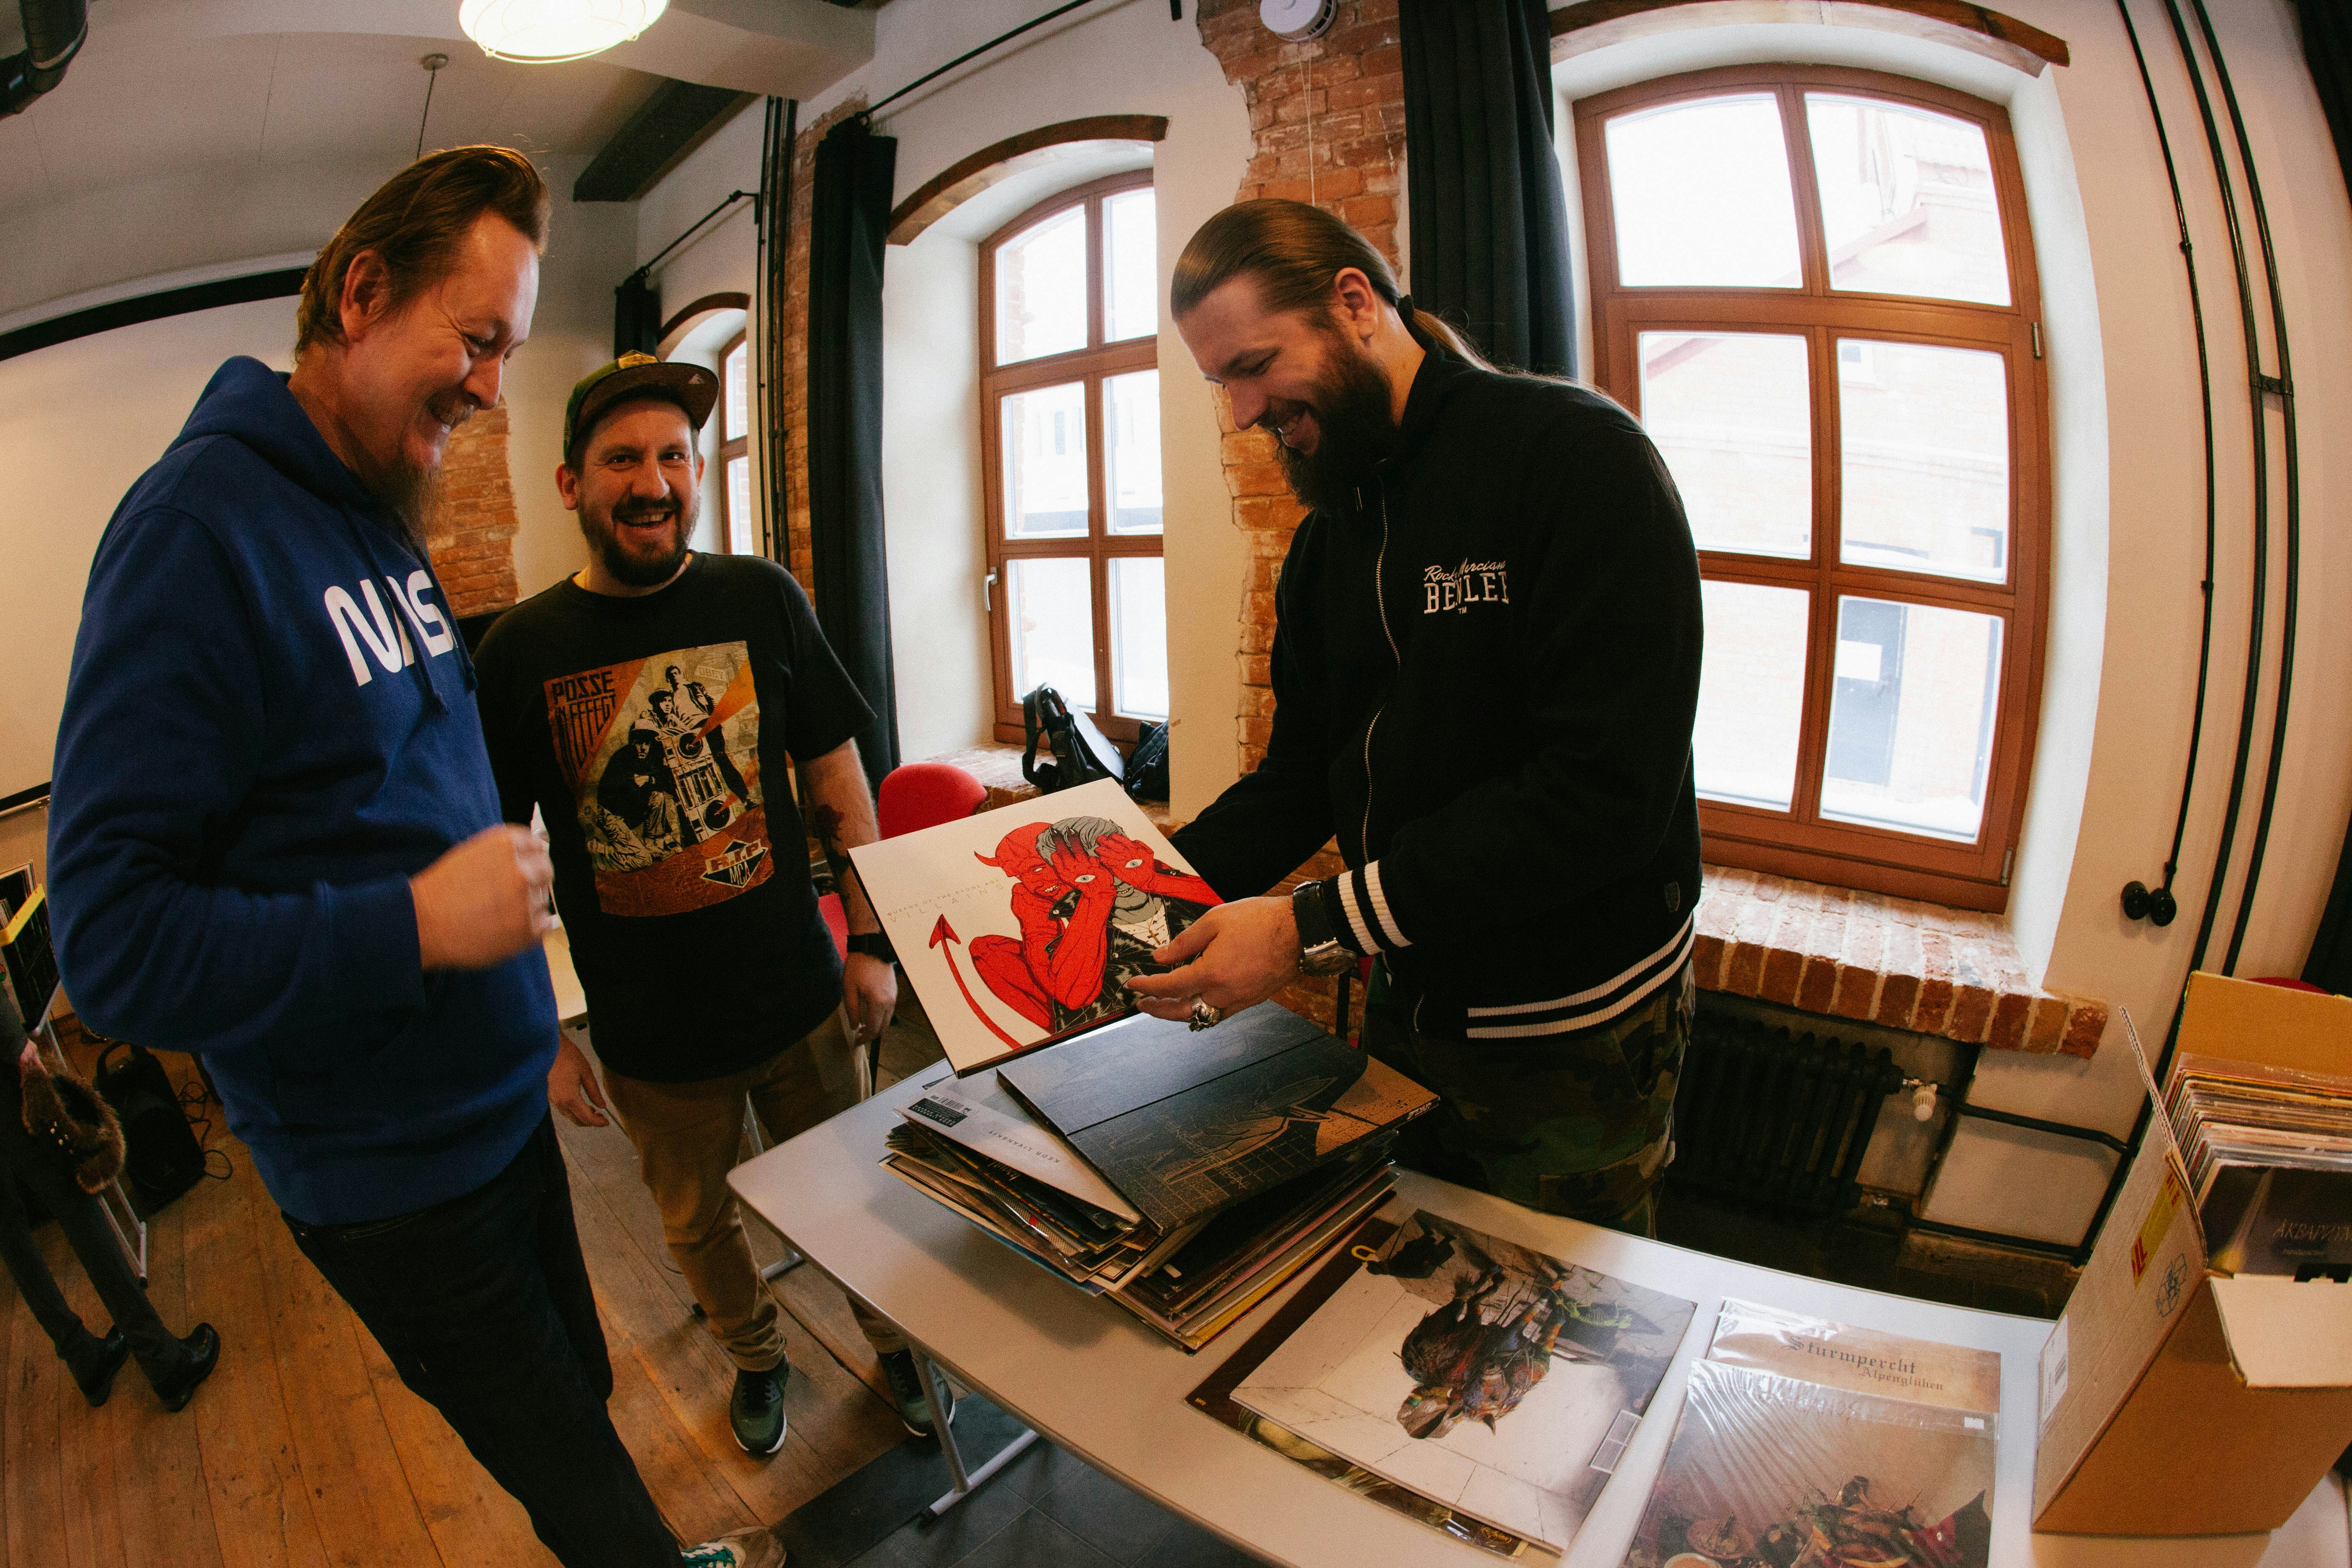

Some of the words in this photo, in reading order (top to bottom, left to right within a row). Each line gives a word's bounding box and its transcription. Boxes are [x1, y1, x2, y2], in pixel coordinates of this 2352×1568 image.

[552, 671, 615, 705] POSSE
[729, 861, 750, 885] MCA
[887, 903, 918, 916] QUEENS
[955, 884, 981, 895] STONE
[890, 884, 1003, 923] VILLAINS
[988, 1131, 1032, 1151] LIVANSKIY
[1036, 1151, 1060, 1163] KEDR
[1781, 1335, 1916, 1374] Sturmpercht
